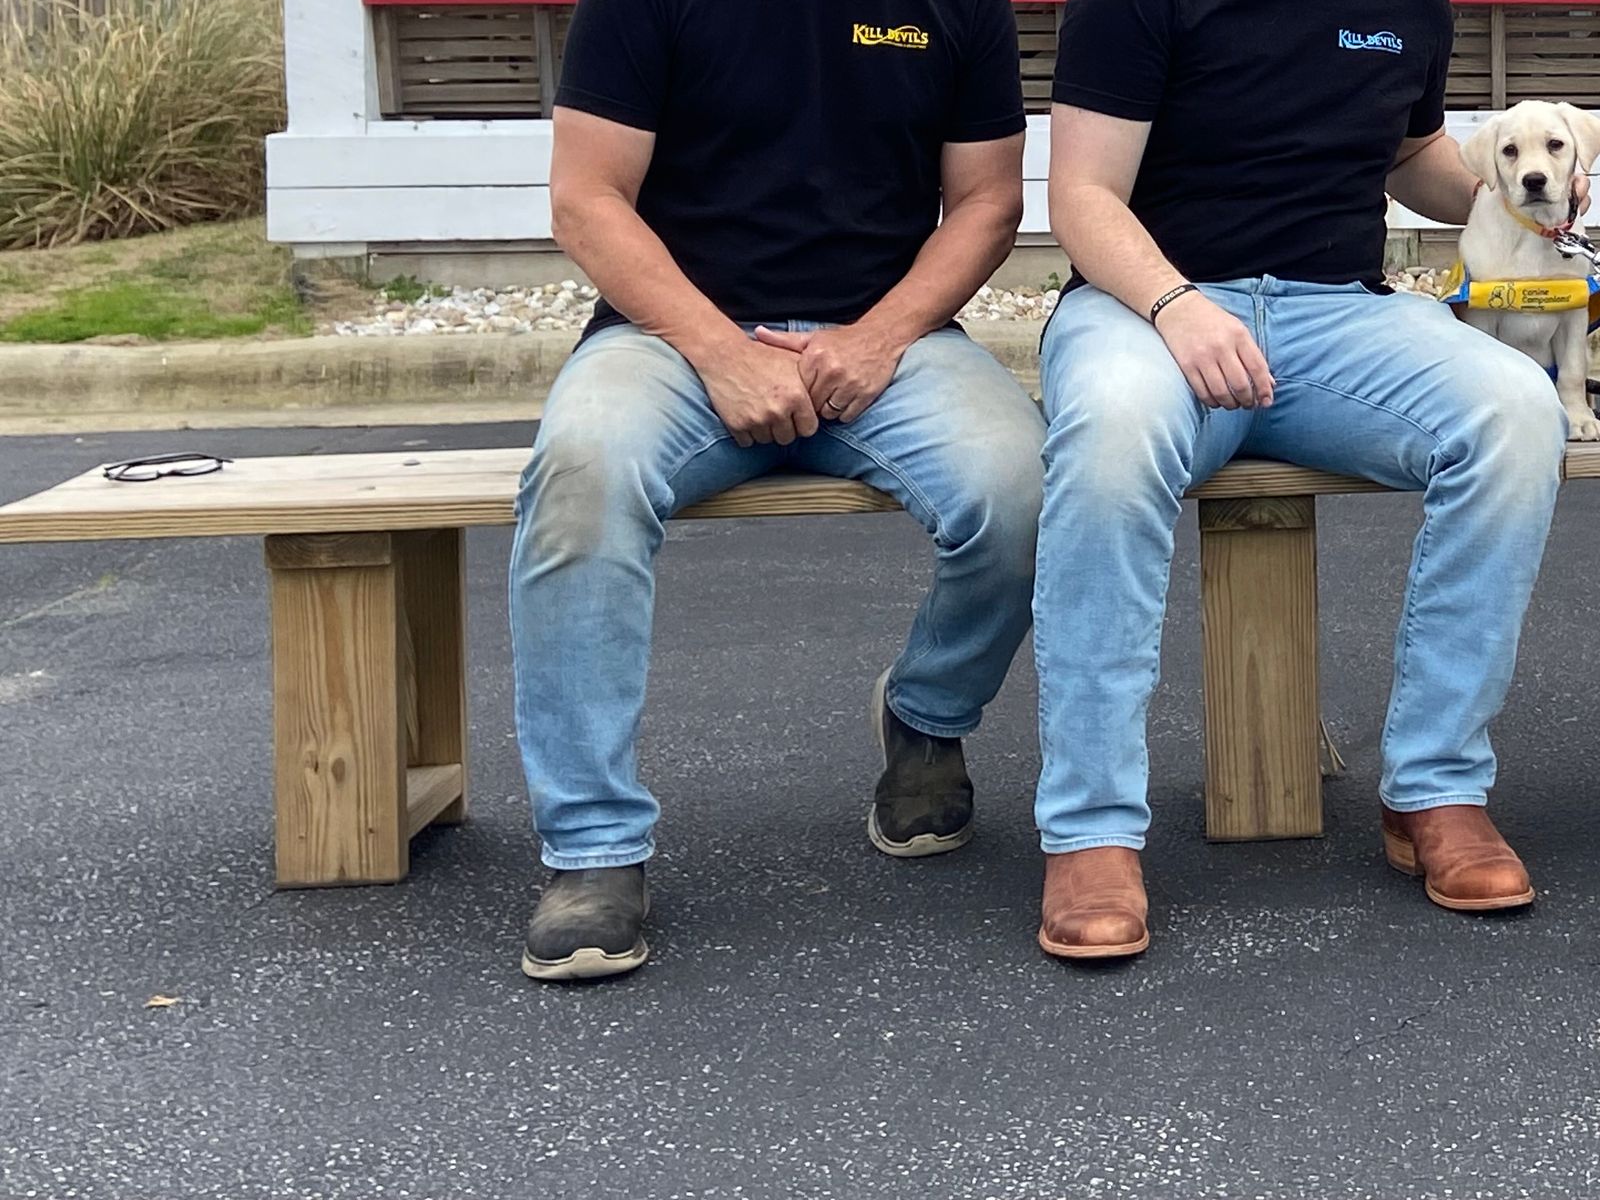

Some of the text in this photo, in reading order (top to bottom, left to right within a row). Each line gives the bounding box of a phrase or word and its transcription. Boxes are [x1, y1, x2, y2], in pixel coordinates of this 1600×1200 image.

[852, 23, 883, 45] KILL
[887, 27, 929, 45] DEVILS
[1338, 29, 1403, 50] KILL DEVILS
[1522, 287, 1550, 296] Canine
